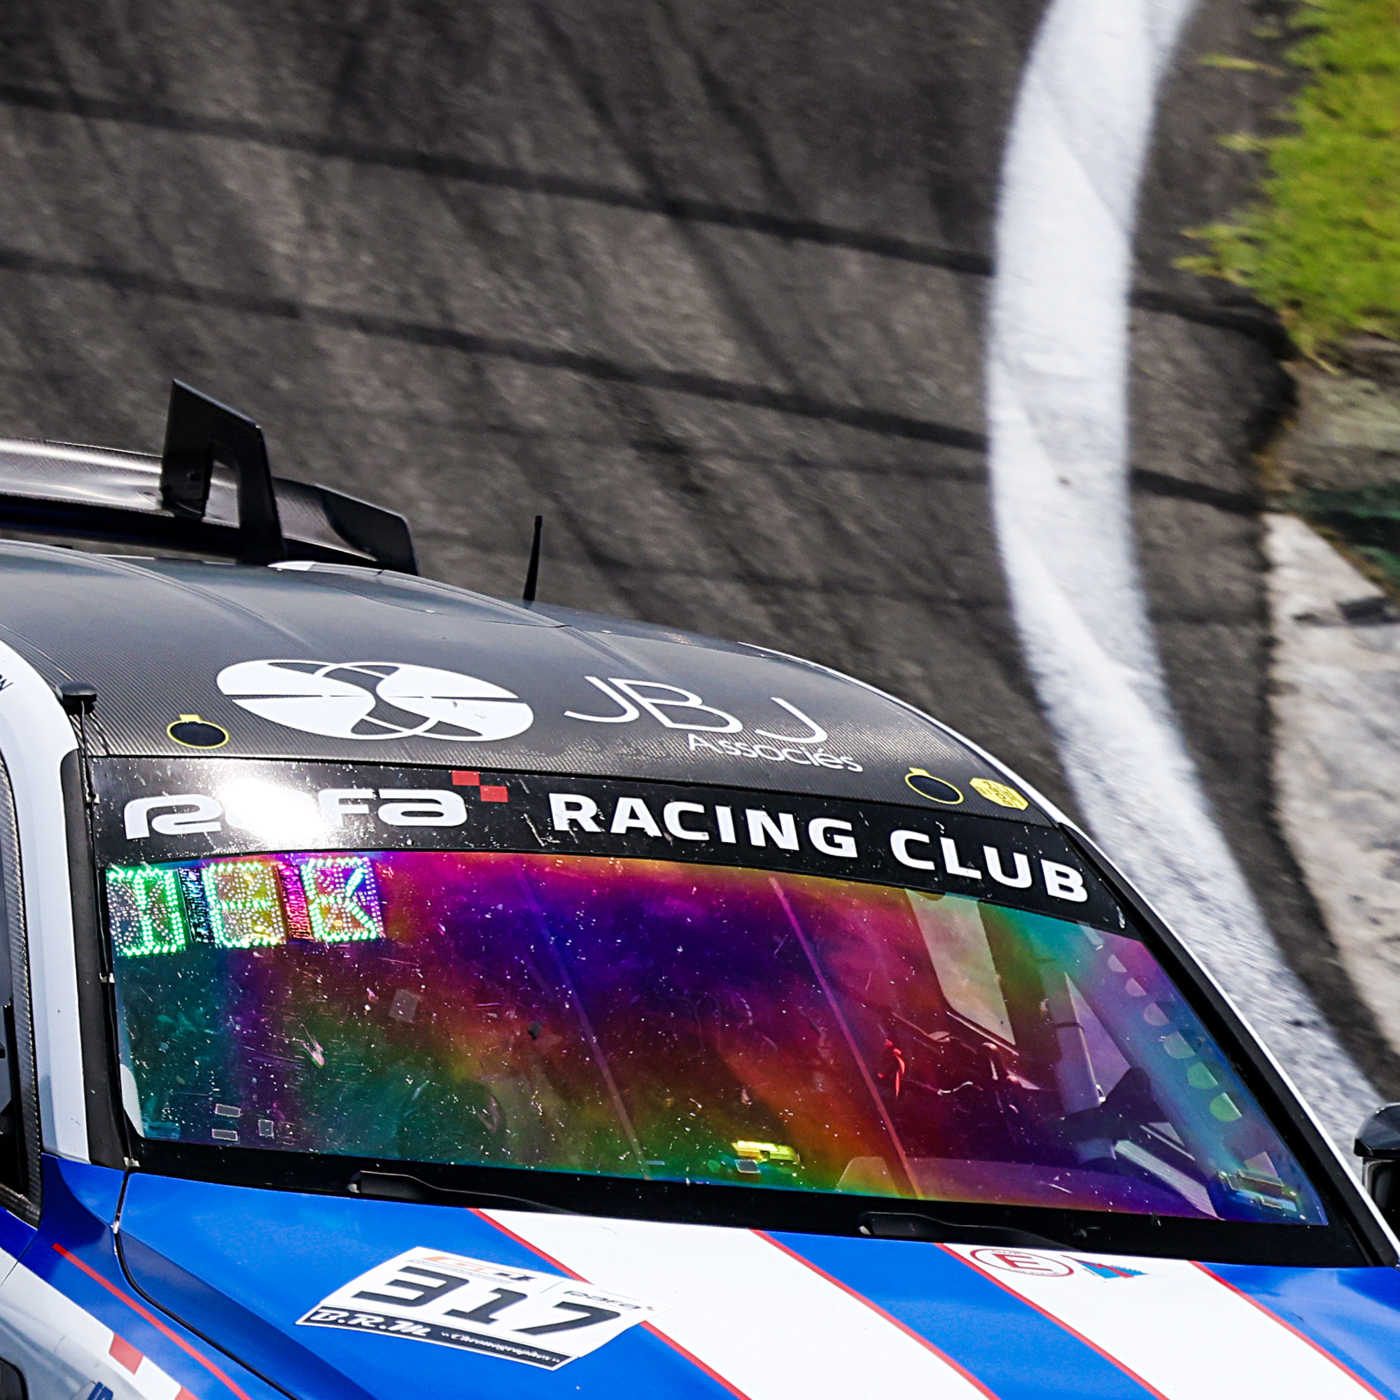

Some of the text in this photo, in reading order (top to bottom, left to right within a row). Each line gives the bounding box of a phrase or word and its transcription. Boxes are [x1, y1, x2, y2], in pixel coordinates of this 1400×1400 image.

[687, 733, 863, 772] Associés
[548, 792, 859, 860] RACING
[889, 829, 1090, 904] CLUB
[350, 1265, 621, 1337] 317
